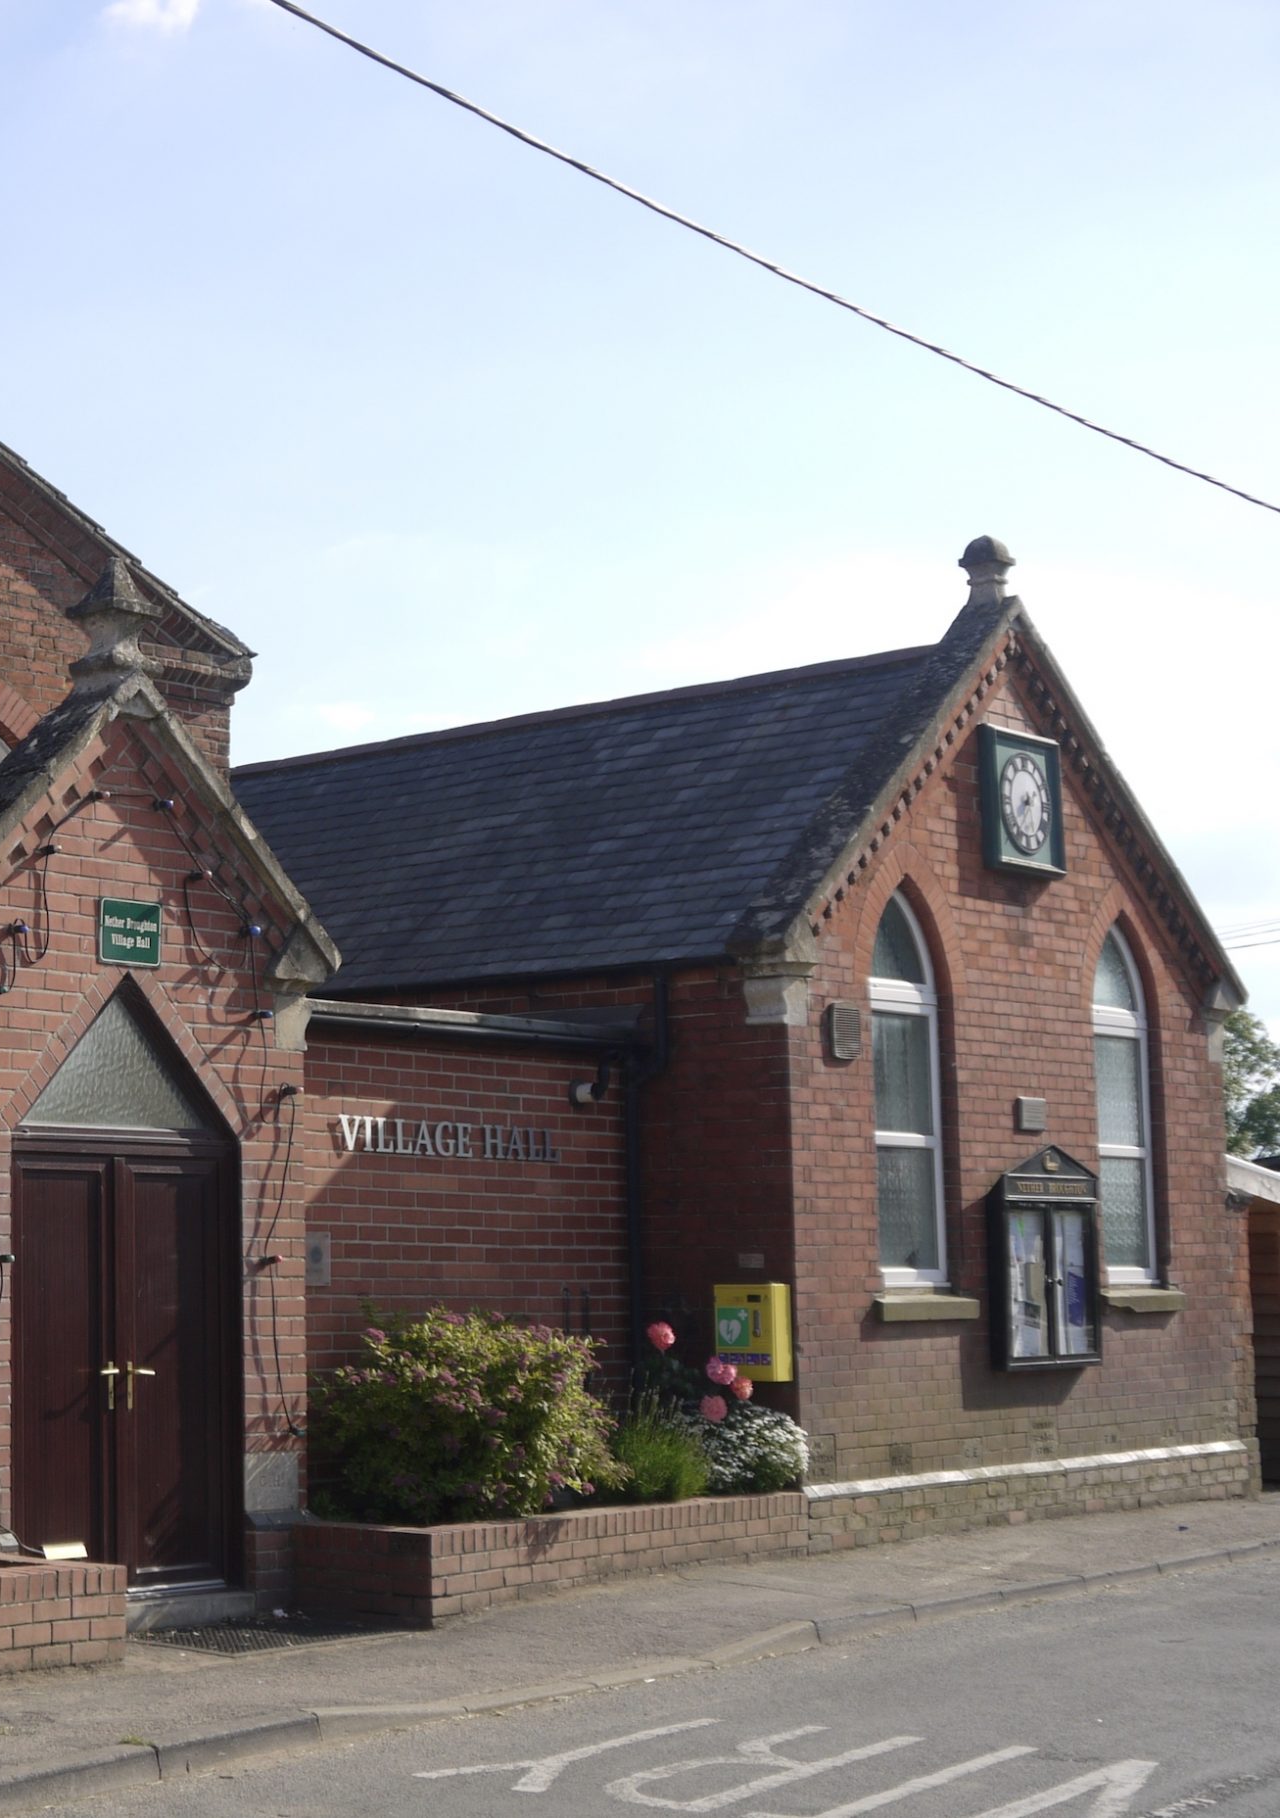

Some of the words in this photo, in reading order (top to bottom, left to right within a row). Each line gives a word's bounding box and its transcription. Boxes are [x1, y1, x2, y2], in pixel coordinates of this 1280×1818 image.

[111, 933, 135, 949] Village
[136, 936, 151, 948] Hall
[338, 1113, 473, 1159] VILLAGE
[483, 1124, 561, 1162] HALL
